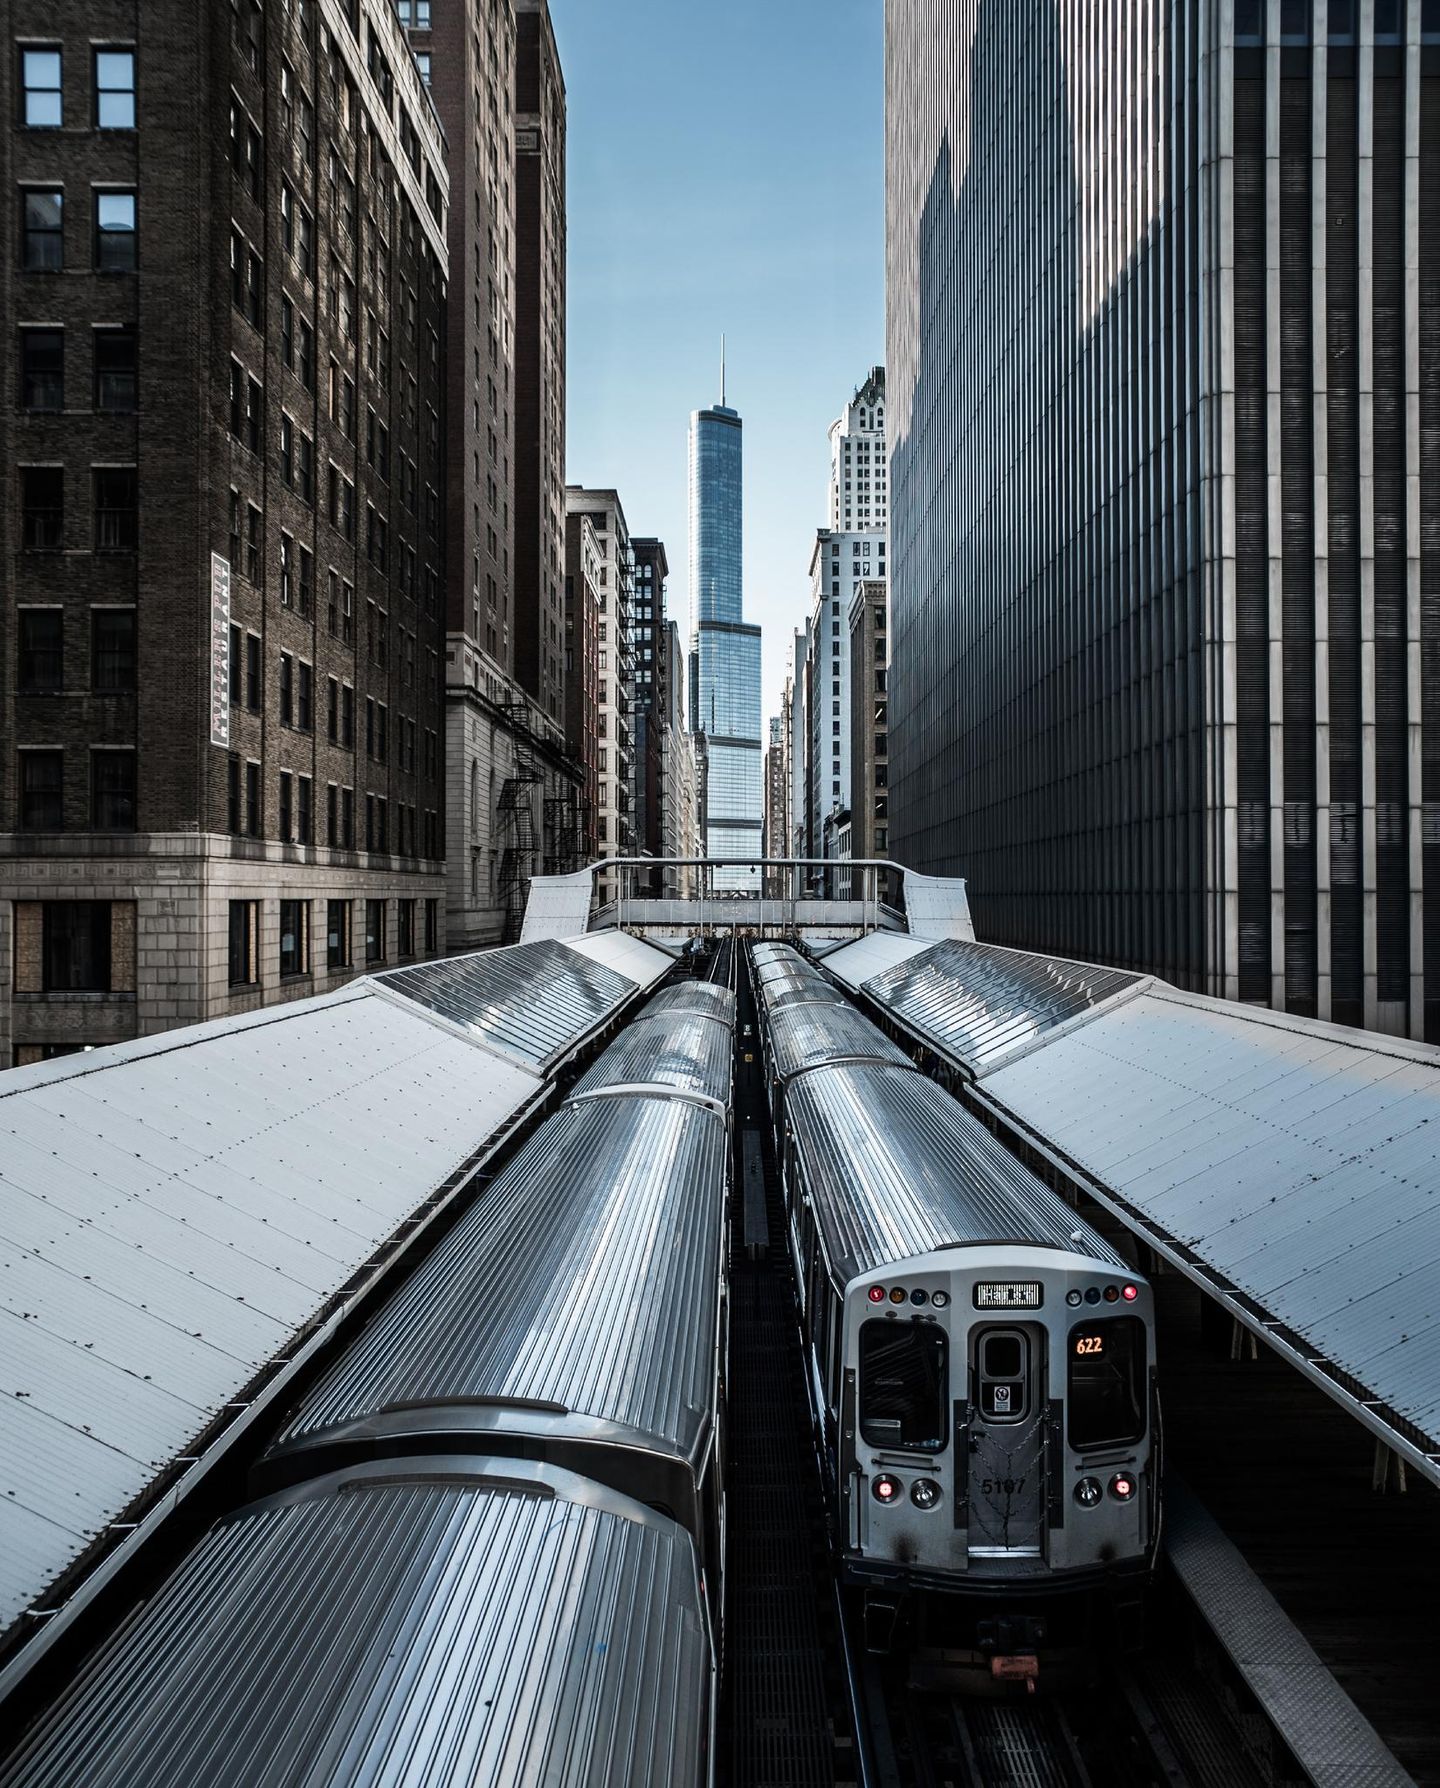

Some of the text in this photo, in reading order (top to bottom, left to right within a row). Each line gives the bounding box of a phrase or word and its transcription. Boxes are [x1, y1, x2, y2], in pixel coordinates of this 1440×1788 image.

[213, 563, 222, 733] MILLER'S PUB
[220, 567, 229, 738] RESTAURANT
[1076, 1336, 1103, 1355] 622
